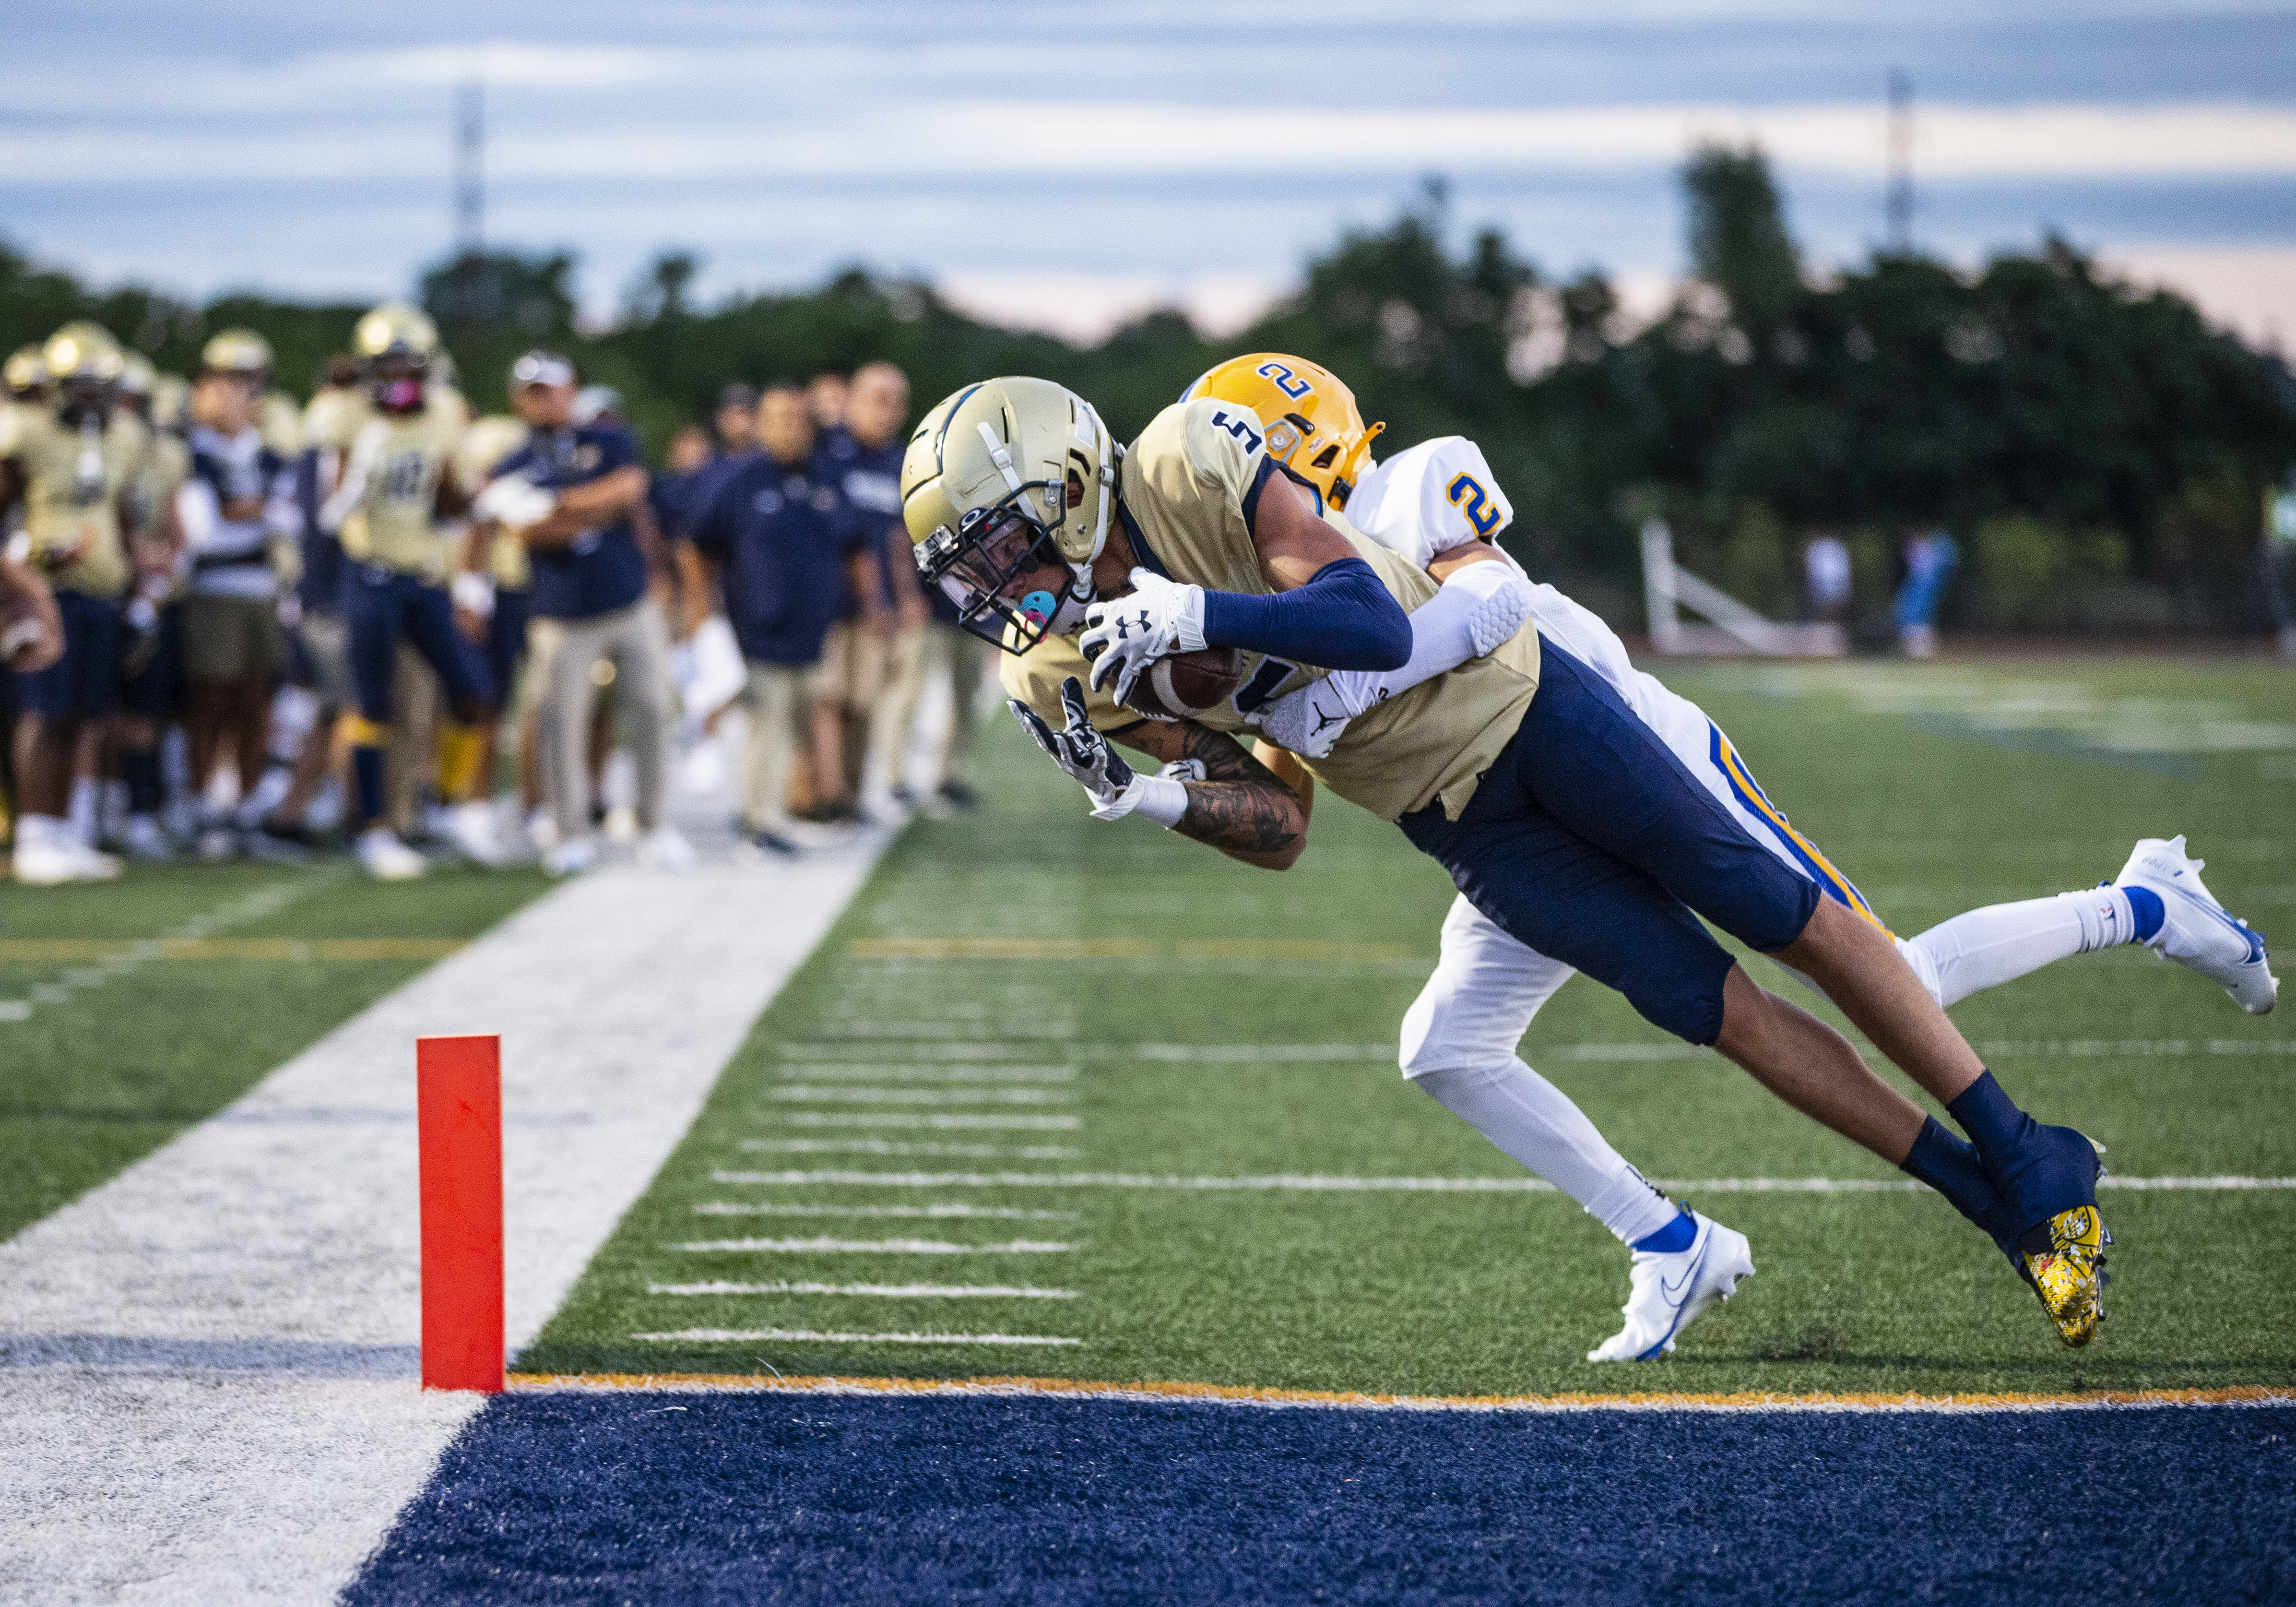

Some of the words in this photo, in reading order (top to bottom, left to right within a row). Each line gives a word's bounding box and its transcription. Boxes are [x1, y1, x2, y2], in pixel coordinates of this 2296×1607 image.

[1256, 362, 1315, 402] 2
[1208, 408, 1267, 460] 5
[1446, 471, 1504, 538] 2
